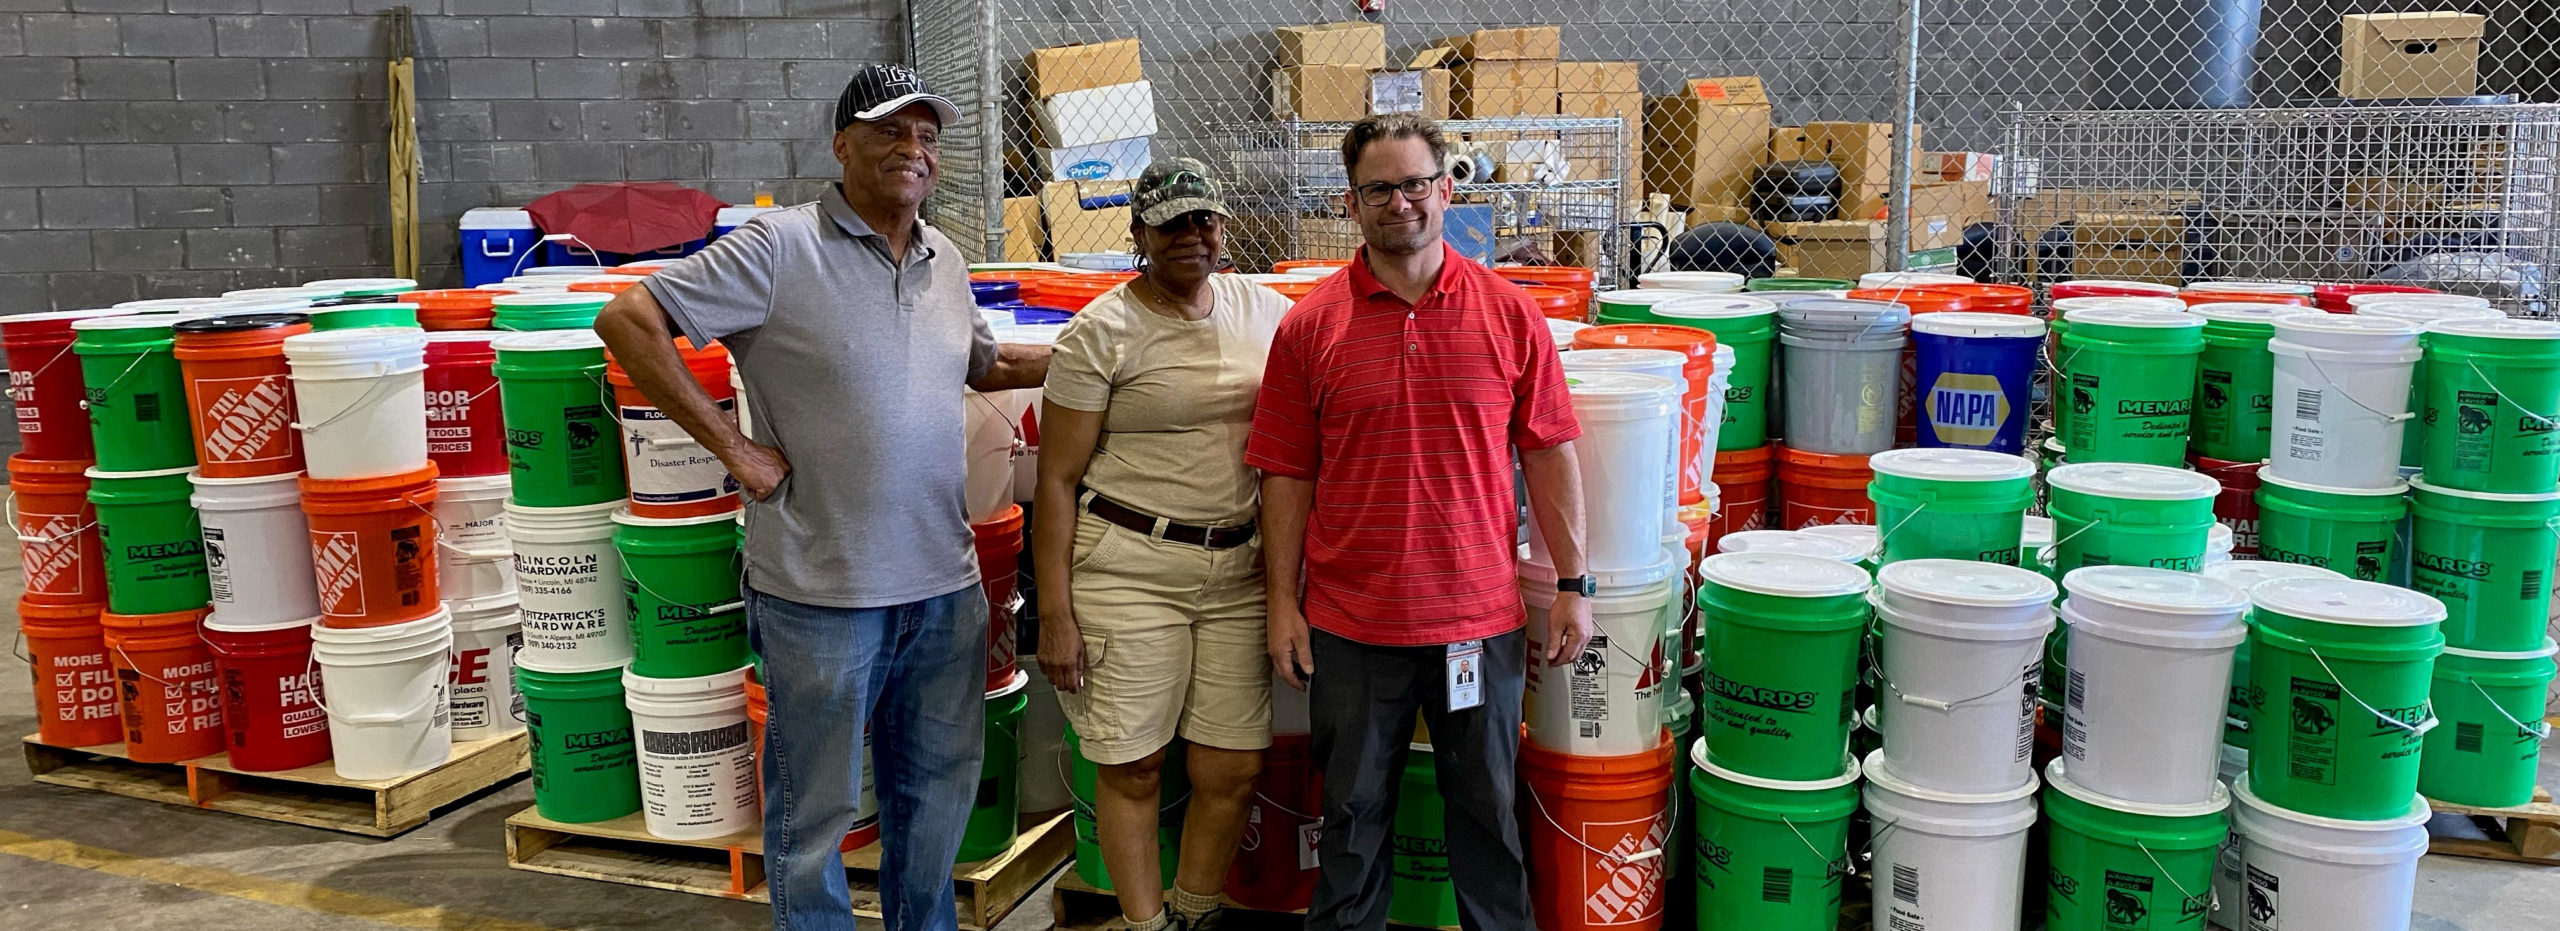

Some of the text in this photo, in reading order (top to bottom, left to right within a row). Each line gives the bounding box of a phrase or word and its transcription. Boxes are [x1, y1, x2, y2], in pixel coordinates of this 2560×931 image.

[1070, 165, 1110, 178] ProPac
[208, 388, 243, 421] THE
[1937, 390, 1996, 427] NAPA
[2118, 398, 2192, 415] MENAR
[206, 376, 288, 462] HOME
[237, 406, 289, 461] DEPOT
[433, 428, 468, 437] TOOLS
[431, 442, 470, 451] PRICES
[650, 455, 718, 468] Disaster Respo
[466, 519, 494, 529] MAJOR
[128, 540, 203, 560] MENA
[522, 554, 597, 566] LINCOLN
[33, 545, 80, 592] DEPOT
[523, 564, 598, 576] HARDWARE
[575, 576, 597, 584] 48742
[323, 563, 360, 614] DEPOT
[535, 586, 572, 595] 335-4166
[526, 608, 605, 621] FITZPATRICK'S
[527, 619, 606, 631] HARDWARE
[586, 630, 607, 638] 49707
[541, 642, 577, 650] 340-2132
[54, 654, 103, 668] MORE
[80, 670, 115, 685] FIL
[163, 662, 212, 679] MORE
[279, 671, 322, 692] HAR
[82, 686, 113, 702] DO
[191, 681, 218, 697] FIL
[1634, 691, 1652, 701] The
[194, 713, 222, 730] RE
[284, 708, 327, 722] QUALIT
[1766, 717, 1777, 725] to
[286, 723, 328, 737] LOWEST
[565, 728, 632, 749] MENA
[643, 730, 690, 754] BAKER'S
[1595, 832, 1639, 875] THE
